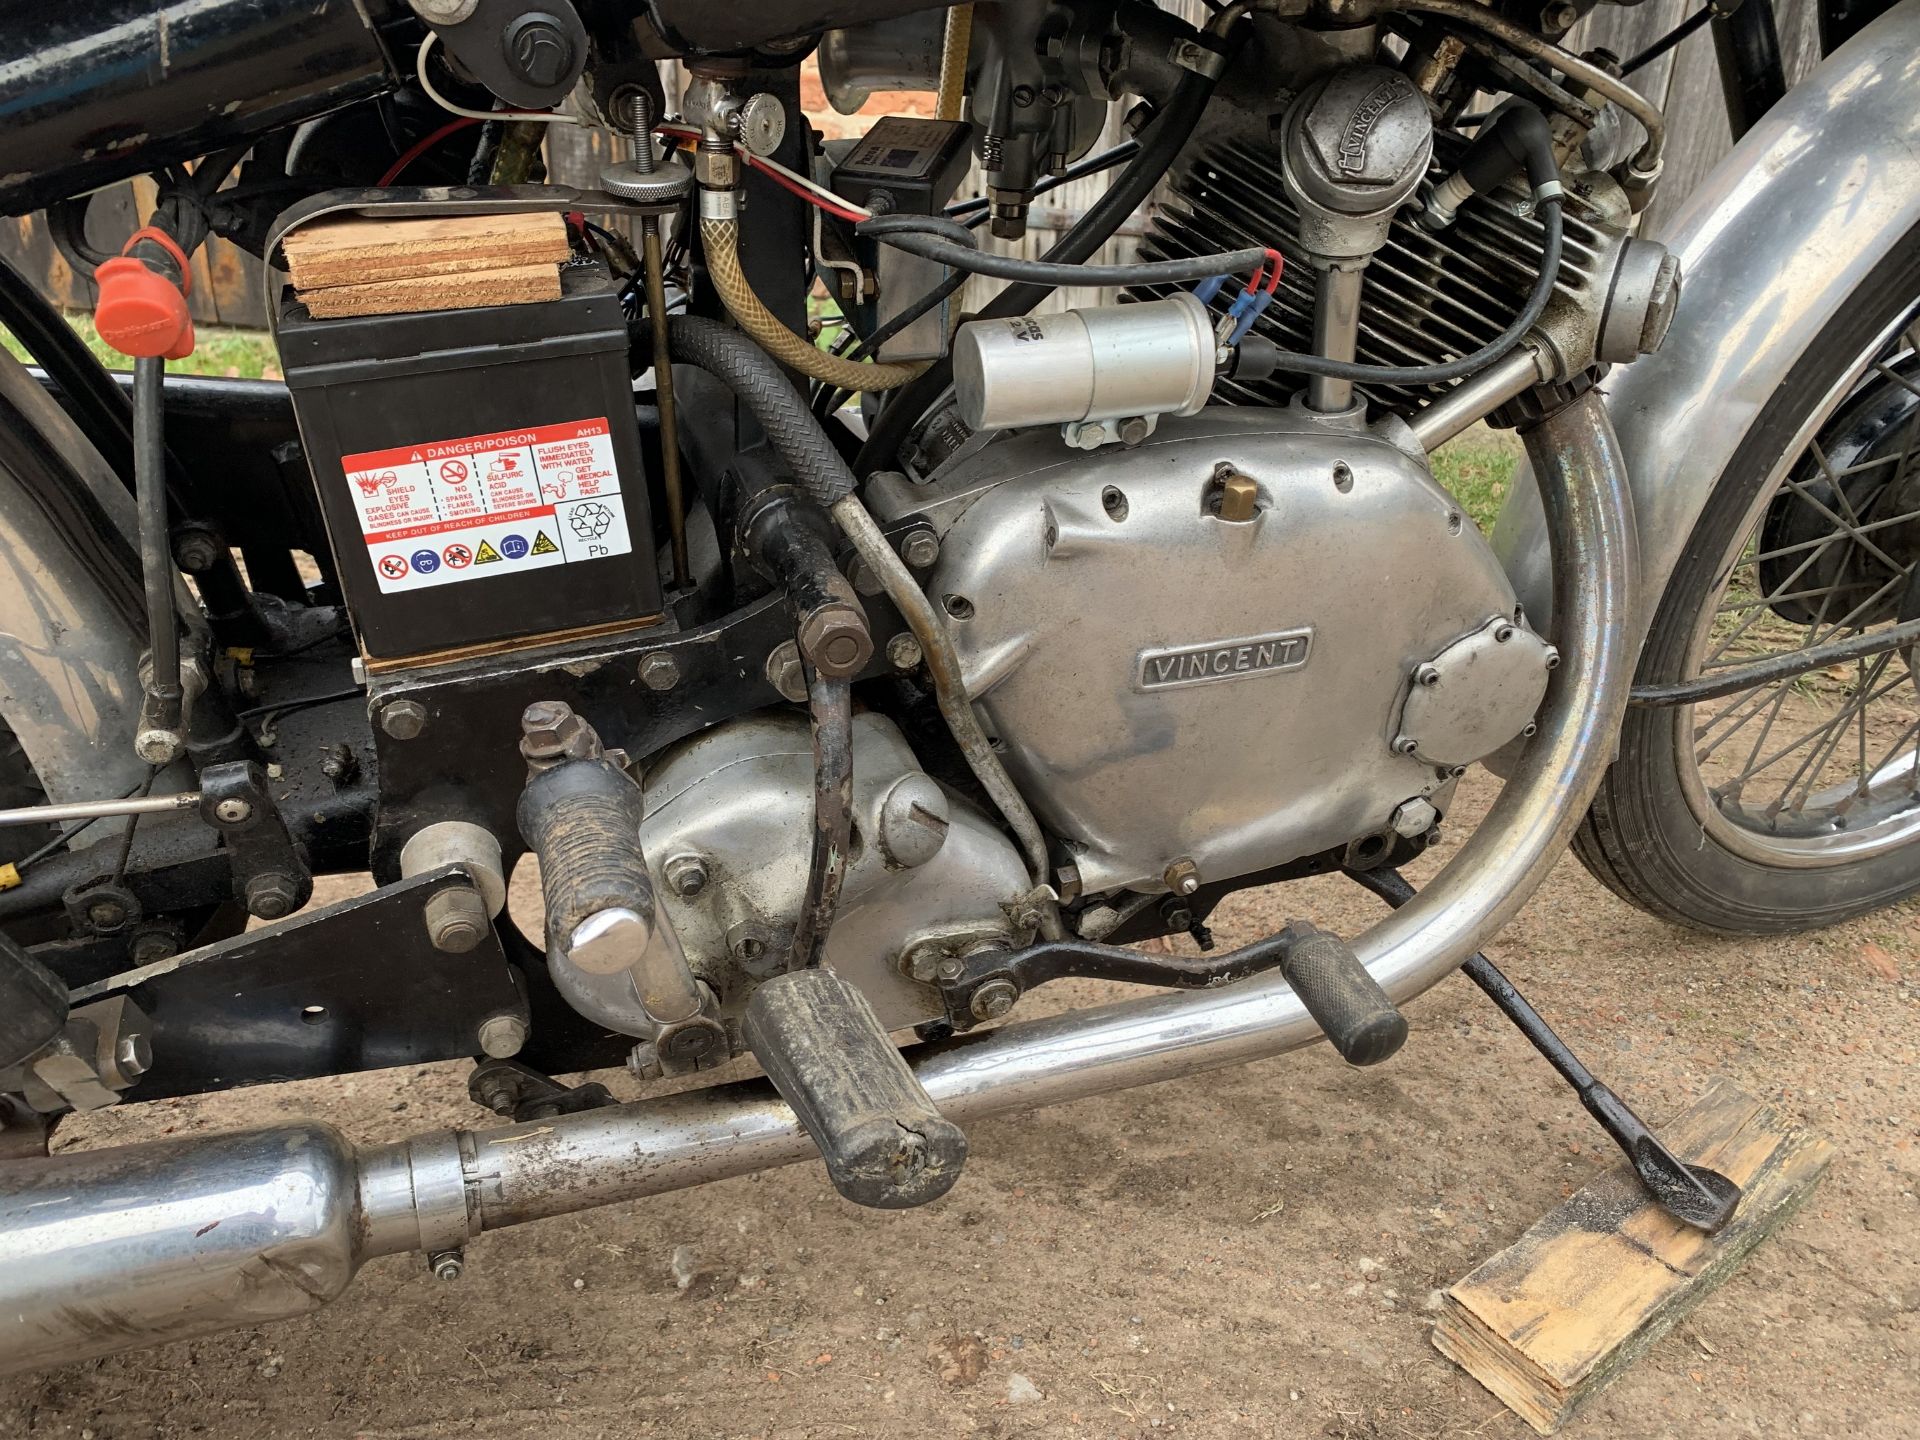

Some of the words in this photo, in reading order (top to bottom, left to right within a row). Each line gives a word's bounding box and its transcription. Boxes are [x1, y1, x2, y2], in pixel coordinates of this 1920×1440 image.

[1348, 87, 1394, 149] VINCENT
[577, 426, 602, 437] AH13
[427, 433, 537, 458] DANGER/POISON
[538, 445, 566, 455] FLUSH
[568, 441, 590, 450] EYES
[539, 448, 594, 463] IMMEDIATELY
[541, 462, 562, 470] WITH
[564, 456, 595, 466] WATER.
[575, 465, 592, 473] GET
[486, 470, 524, 482] SULFURIC
[577, 470, 613, 481] MEDICAL
[455, 485, 468, 493] NO
[489, 481, 507, 490] ACID
[578, 480, 600, 488] HELP
[386, 485, 416, 496] SHIELD
[505, 487, 524, 495] CAUSE
[580, 487, 601, 496] FAST.
[388, 494, 410, 504] EYES
[445, 493, 473, 502] SPARKS
[492, 494, 524, 504] BLINDNESS
[365, 501, 410, 515] EXPLOSIVE
[447, 501, 475, 509] FLAMES
[493, 501, 516, 510] SEVERE
[517, 499, 537, 507] BURNS
[367, 512, 395, 522] GASES
[410, 508, 431, 516] CAUSE
[449, 507, 481, 517] SMOKING
[369, 518, 402, 529] BLINDNESS
[386, 531, 408, 539] KEEP
[411, 527, 427, 535] OUT
[430, 524, 441, 532] OF
[444, 518, 473, 529] REACH
[488, 511, 530, 523] CHILDREN
[589, 545, 609, 557] Pb
[1155, 640, 1298, 681] VINCENT
